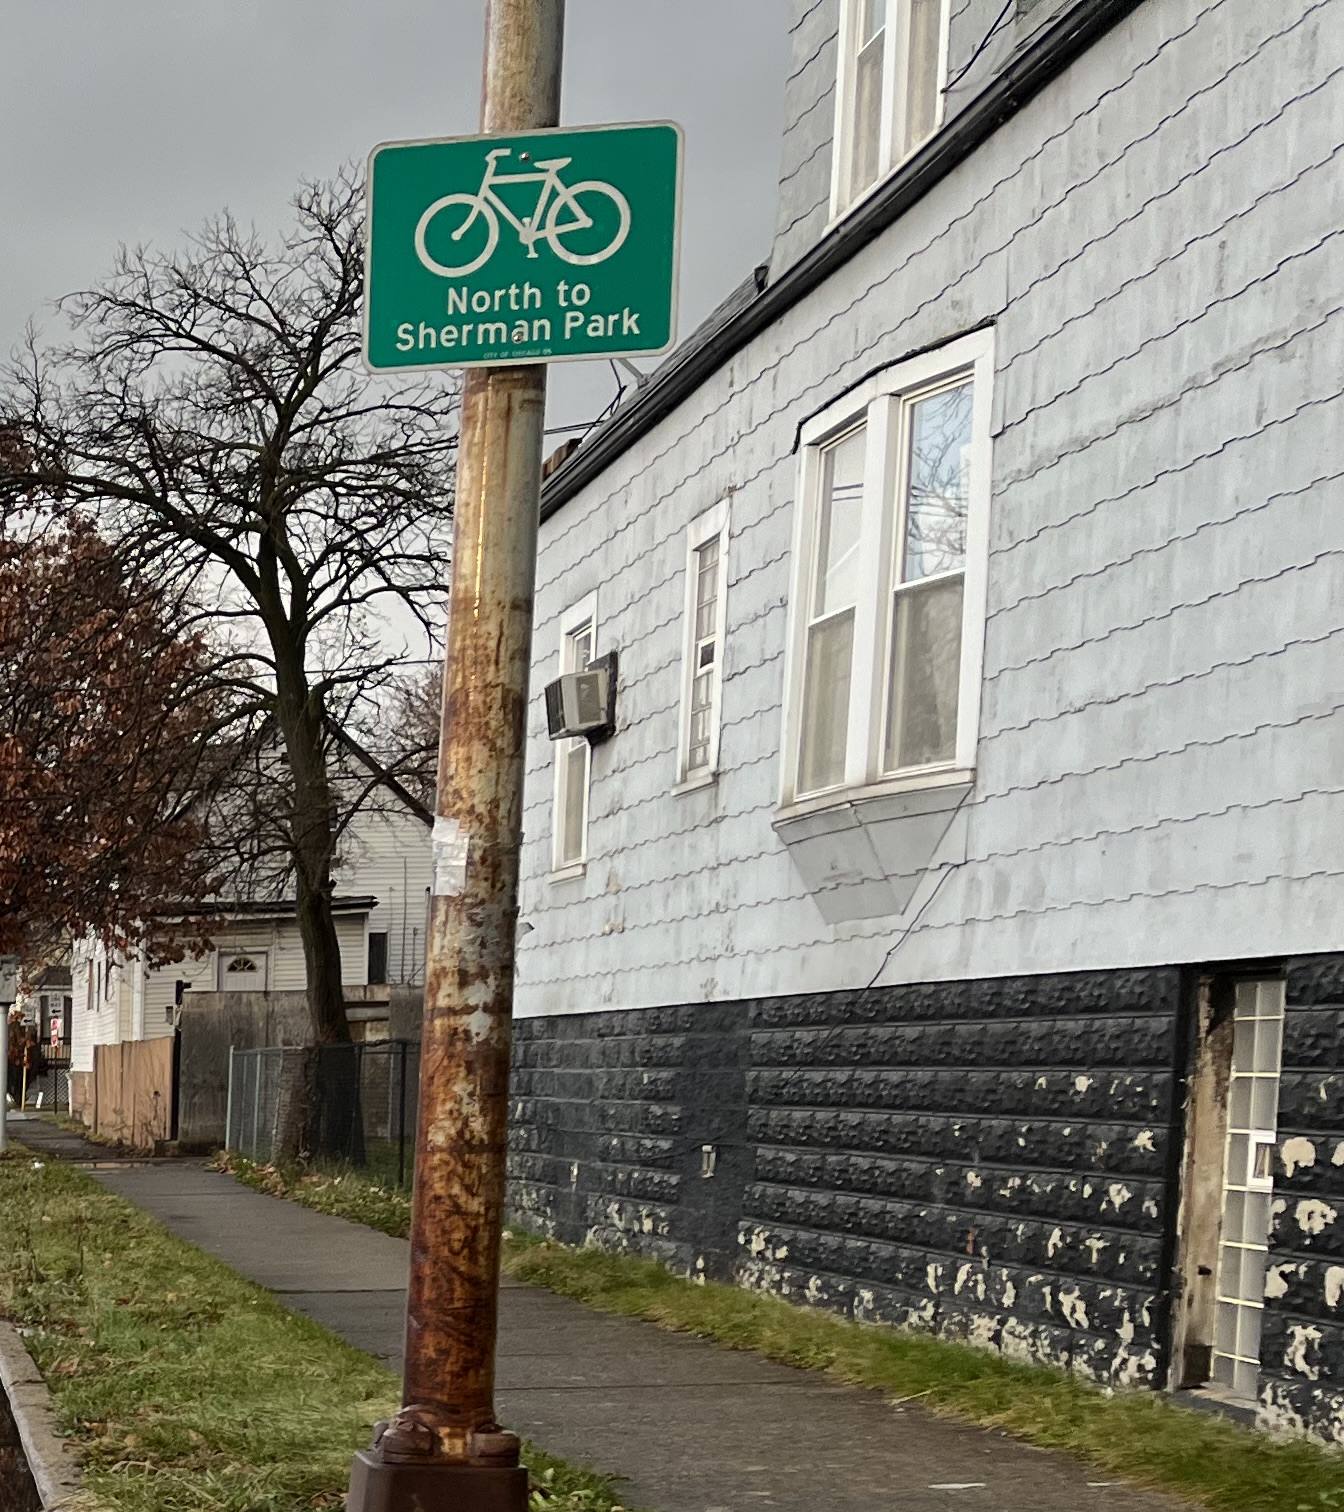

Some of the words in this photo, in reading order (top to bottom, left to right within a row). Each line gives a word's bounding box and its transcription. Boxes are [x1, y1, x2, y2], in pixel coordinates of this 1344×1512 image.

[447, 281, 542, 315] North
[557, 279, 591, 307] to
[396, 317, 551, 351] Sherman
[564, 307, 641, 340] Park
